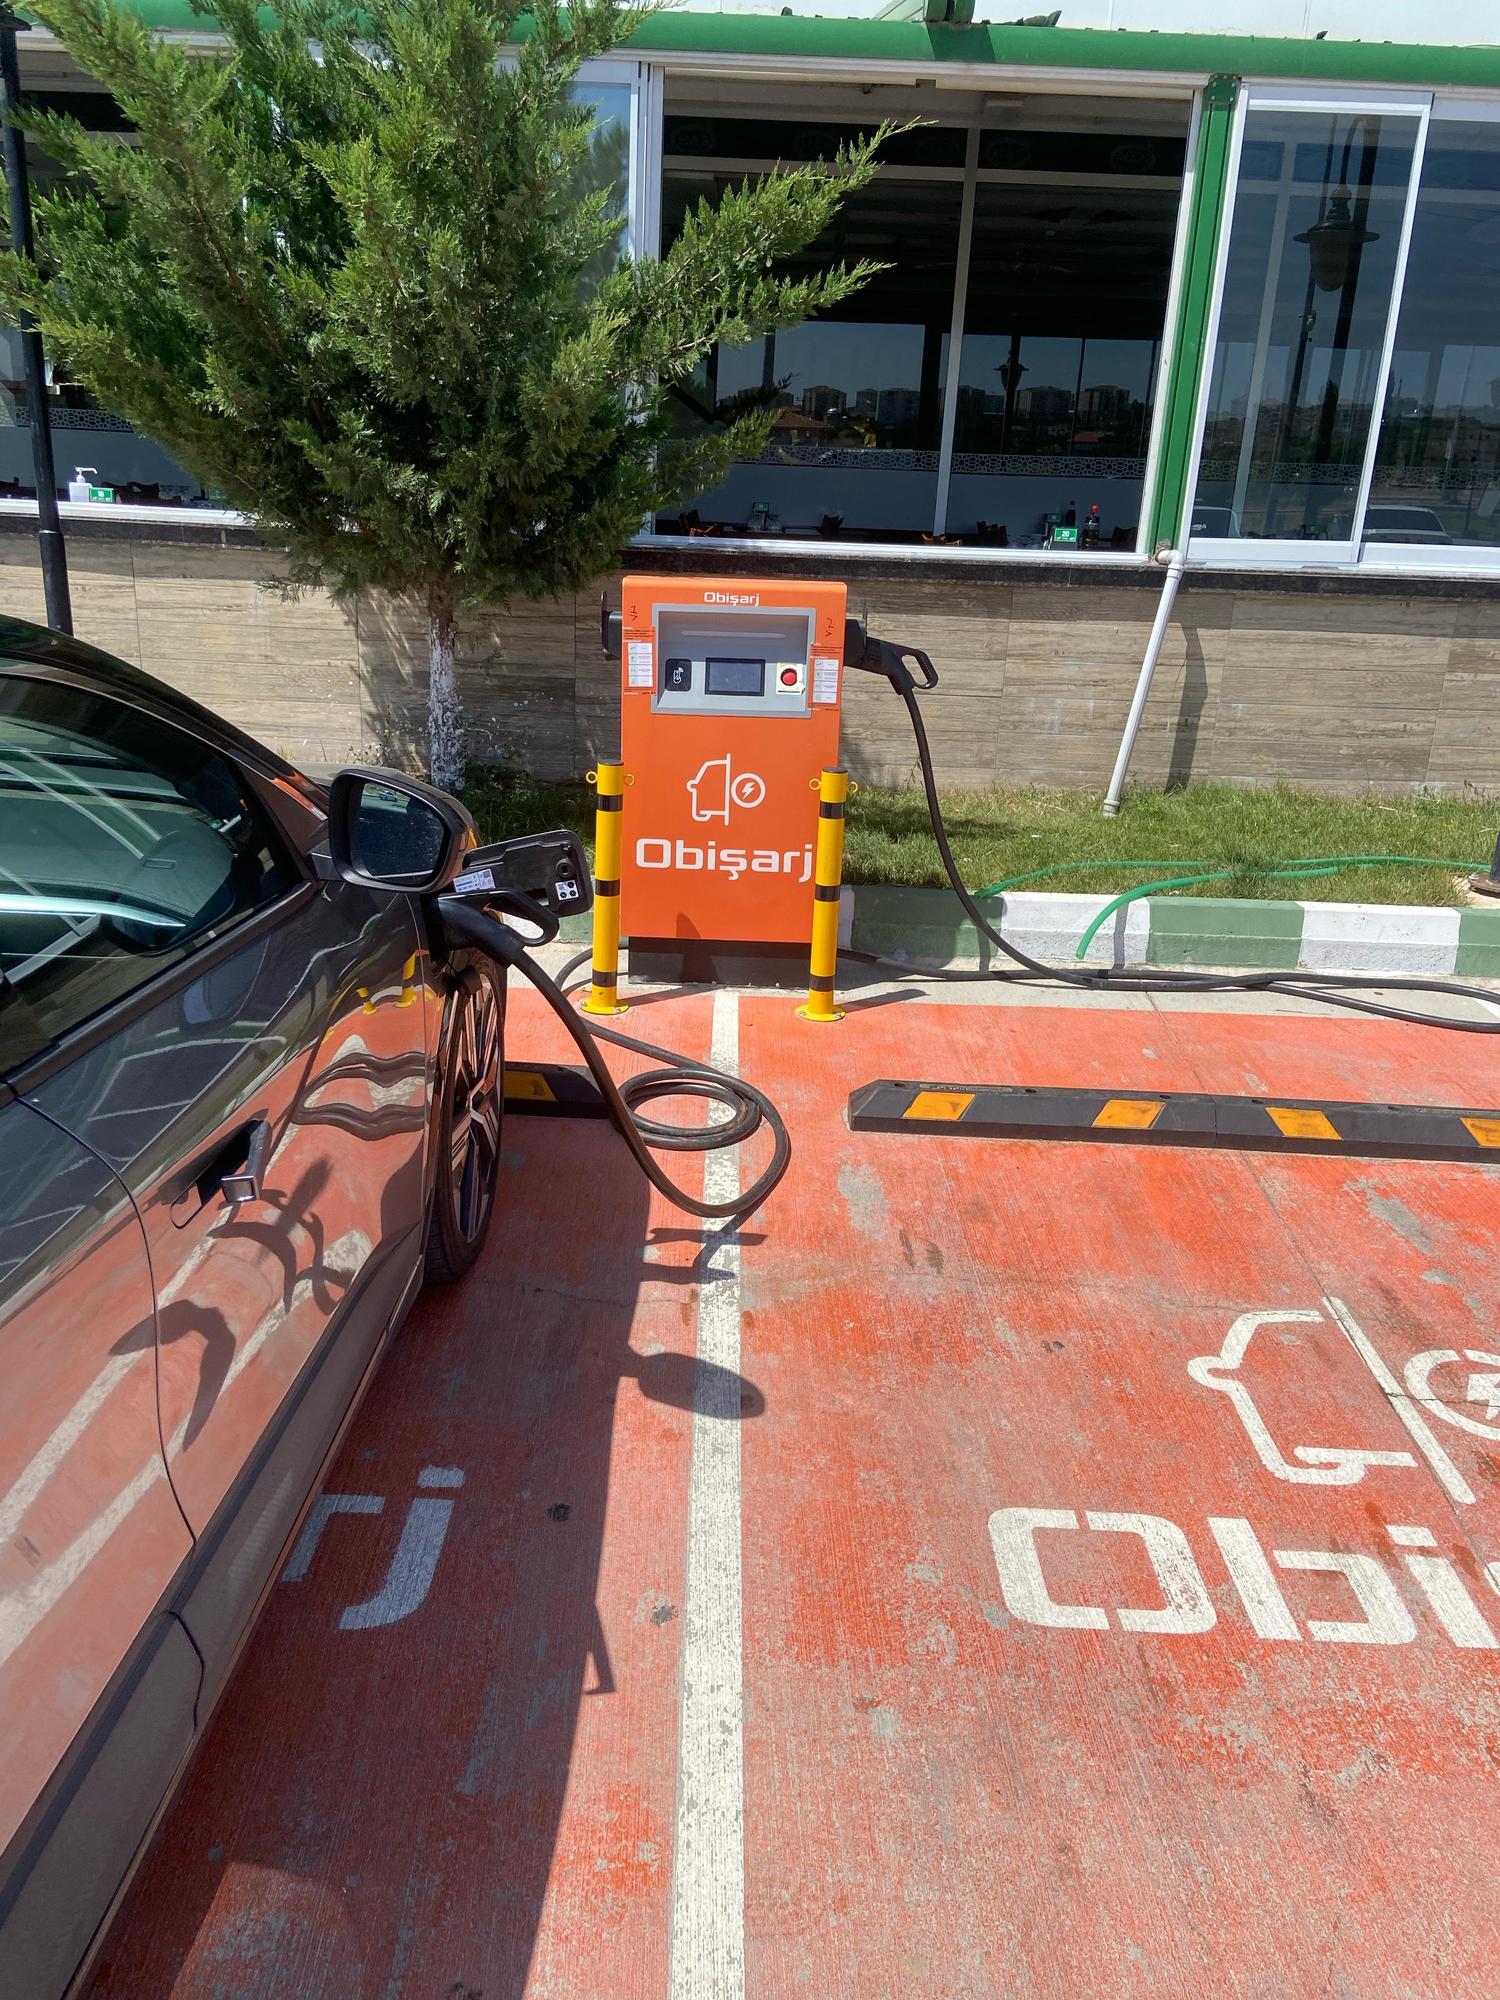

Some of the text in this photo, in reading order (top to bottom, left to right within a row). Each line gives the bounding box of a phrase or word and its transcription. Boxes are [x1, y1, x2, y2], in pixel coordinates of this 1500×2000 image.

[703, 591, 760, 607] Obişarj
[636, 838, 813, 883] Obişarj
[988, 1506, 1500, 1648] Obi
